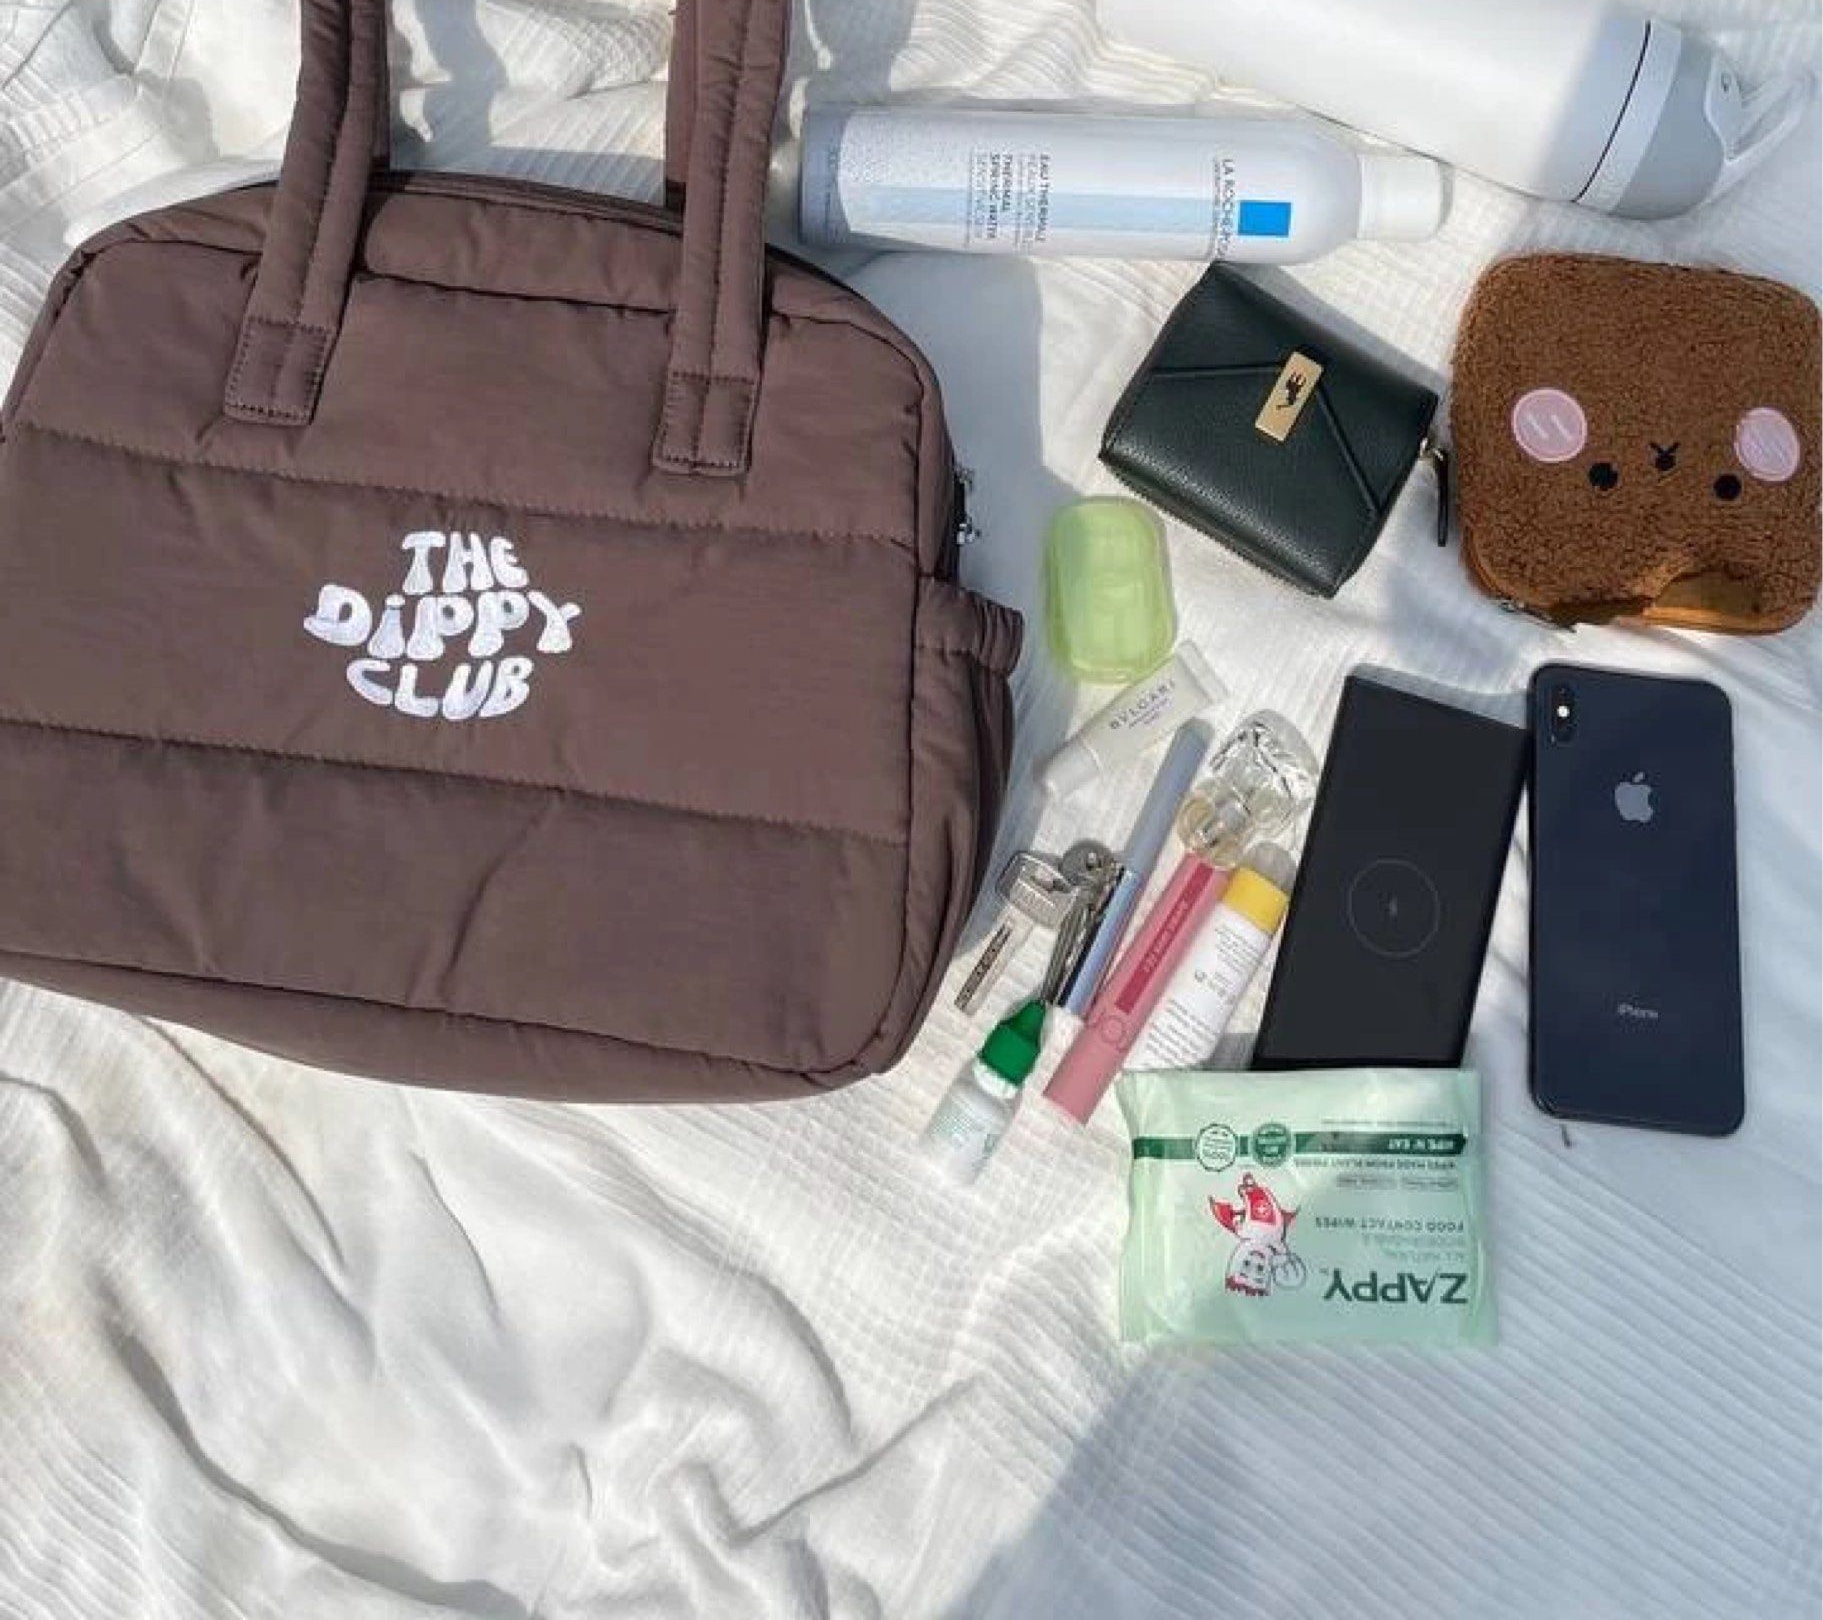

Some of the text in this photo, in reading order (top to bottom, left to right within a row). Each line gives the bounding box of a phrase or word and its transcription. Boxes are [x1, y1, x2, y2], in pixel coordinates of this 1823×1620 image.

[989, 152, 1001, 201] SPRING
[1002, 153, 1014, 212] THERMAL
[1222, 158, 1235, 176] LA
[402, 530, 529, 595] THE
[346, 657, 533, 721] CLUB
[1388, 1138, 1411, 1150] EAT
[1315, 1217, 1465, 1233] FOOD CONTACT WIPES
[1323, 1268, 1468, 1304] ZAPPY
